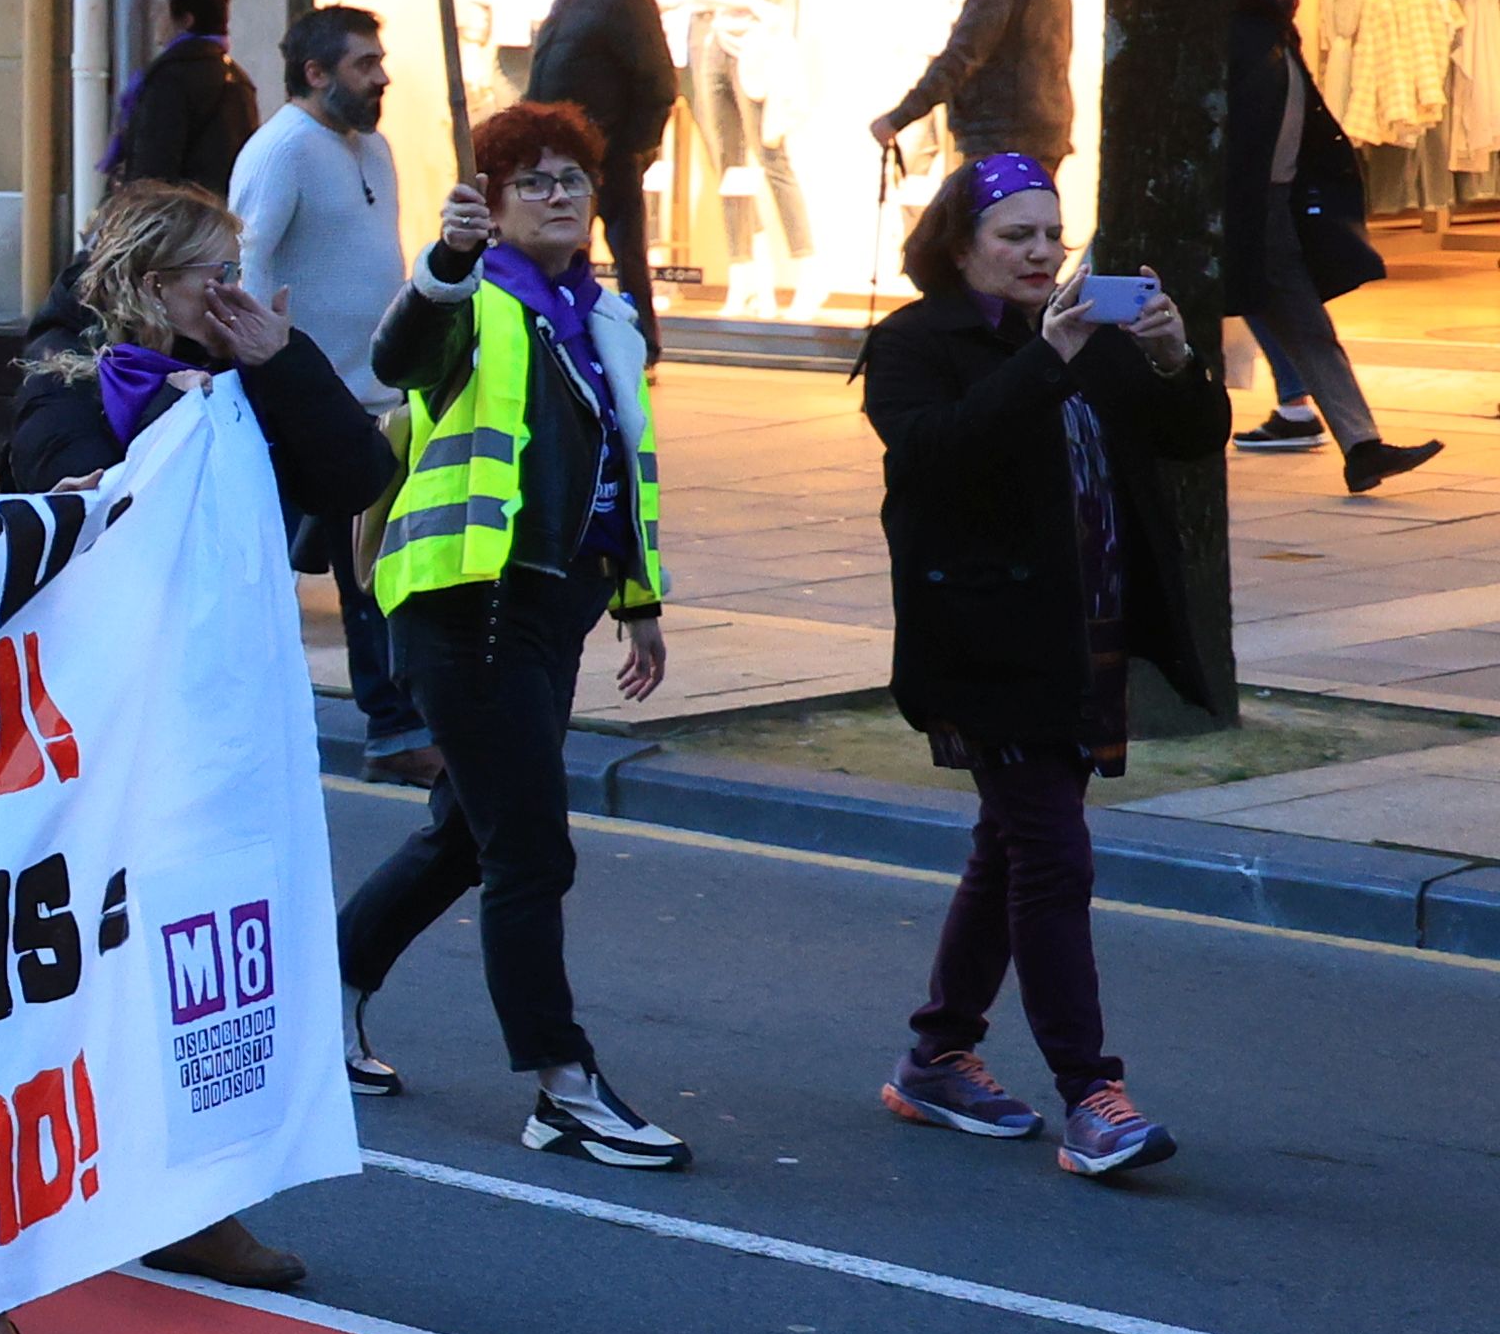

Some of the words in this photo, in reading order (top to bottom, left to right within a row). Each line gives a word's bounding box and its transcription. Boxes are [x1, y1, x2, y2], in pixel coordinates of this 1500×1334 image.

[174, 1006, 276, 1061] ASANBLADA
[181, 1035, 273, 1088] FEMINISTA
[192, 1065, 266, 1113] BIDASOA
